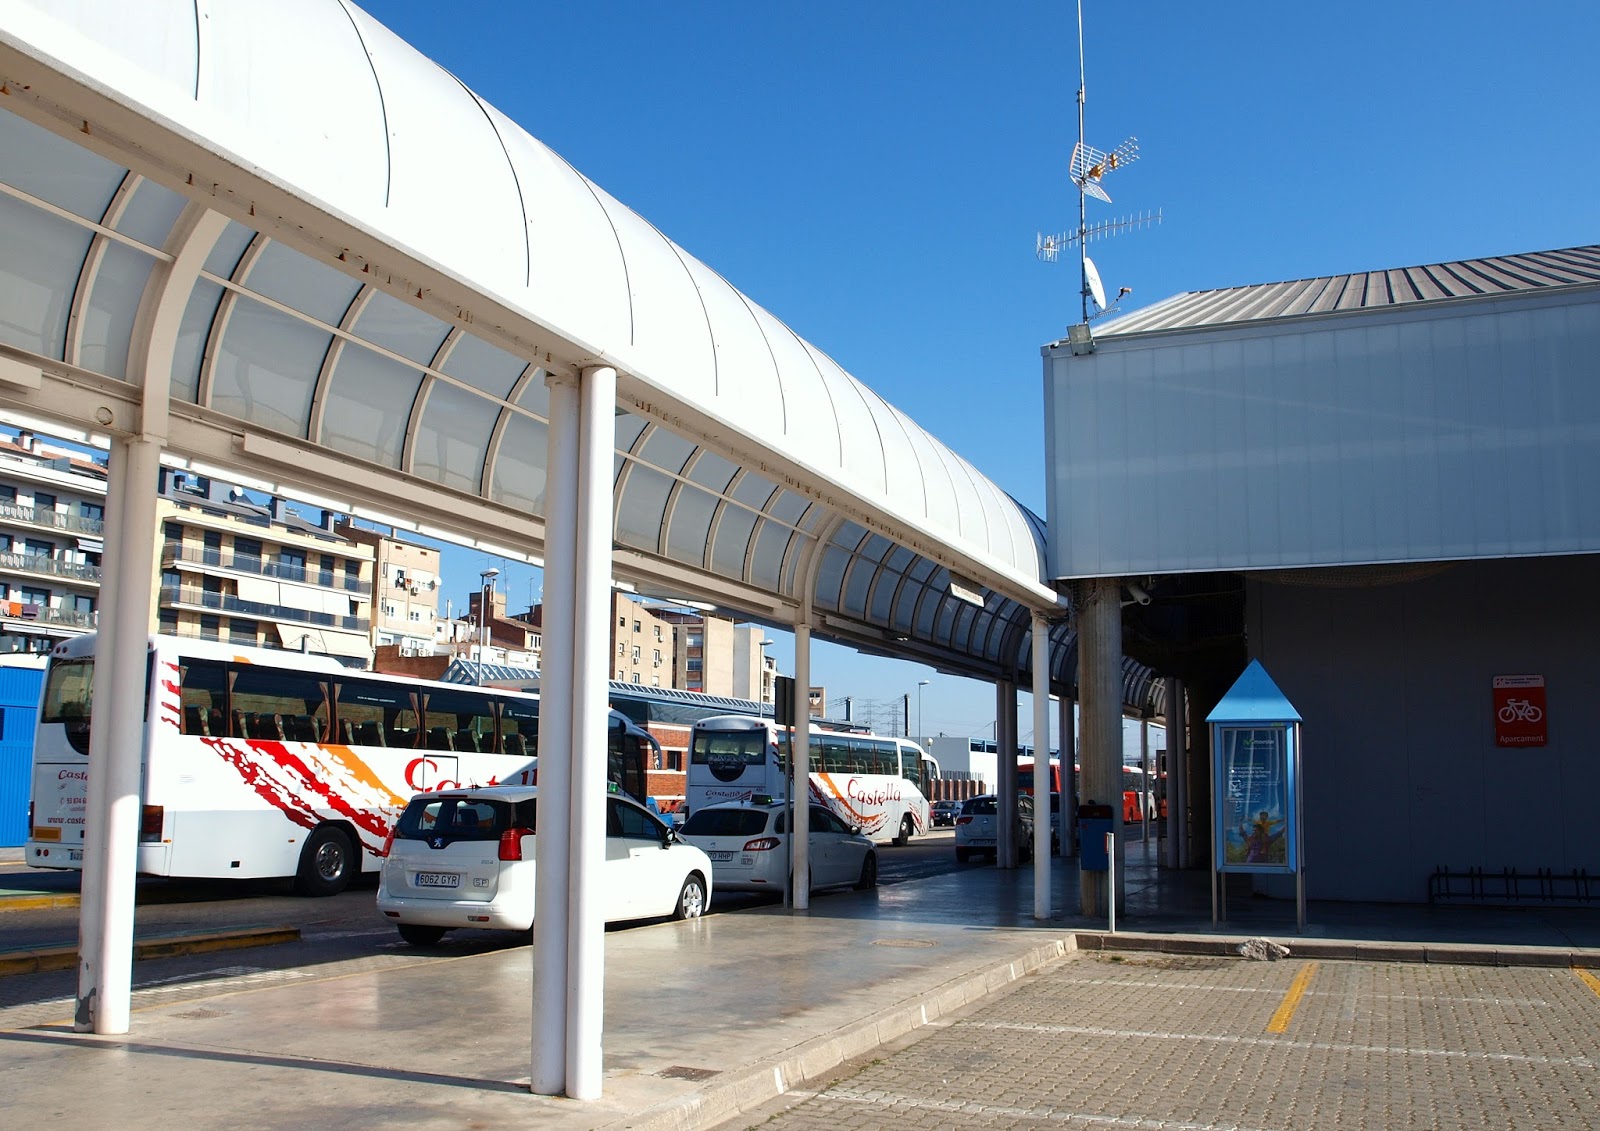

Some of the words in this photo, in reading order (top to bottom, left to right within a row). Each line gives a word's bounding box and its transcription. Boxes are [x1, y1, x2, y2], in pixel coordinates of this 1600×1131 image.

[1499, 735, 1544, 743] Aparcament
[420, 874, 440, 885] 6062
[441, 874, 457, 885] GYR
